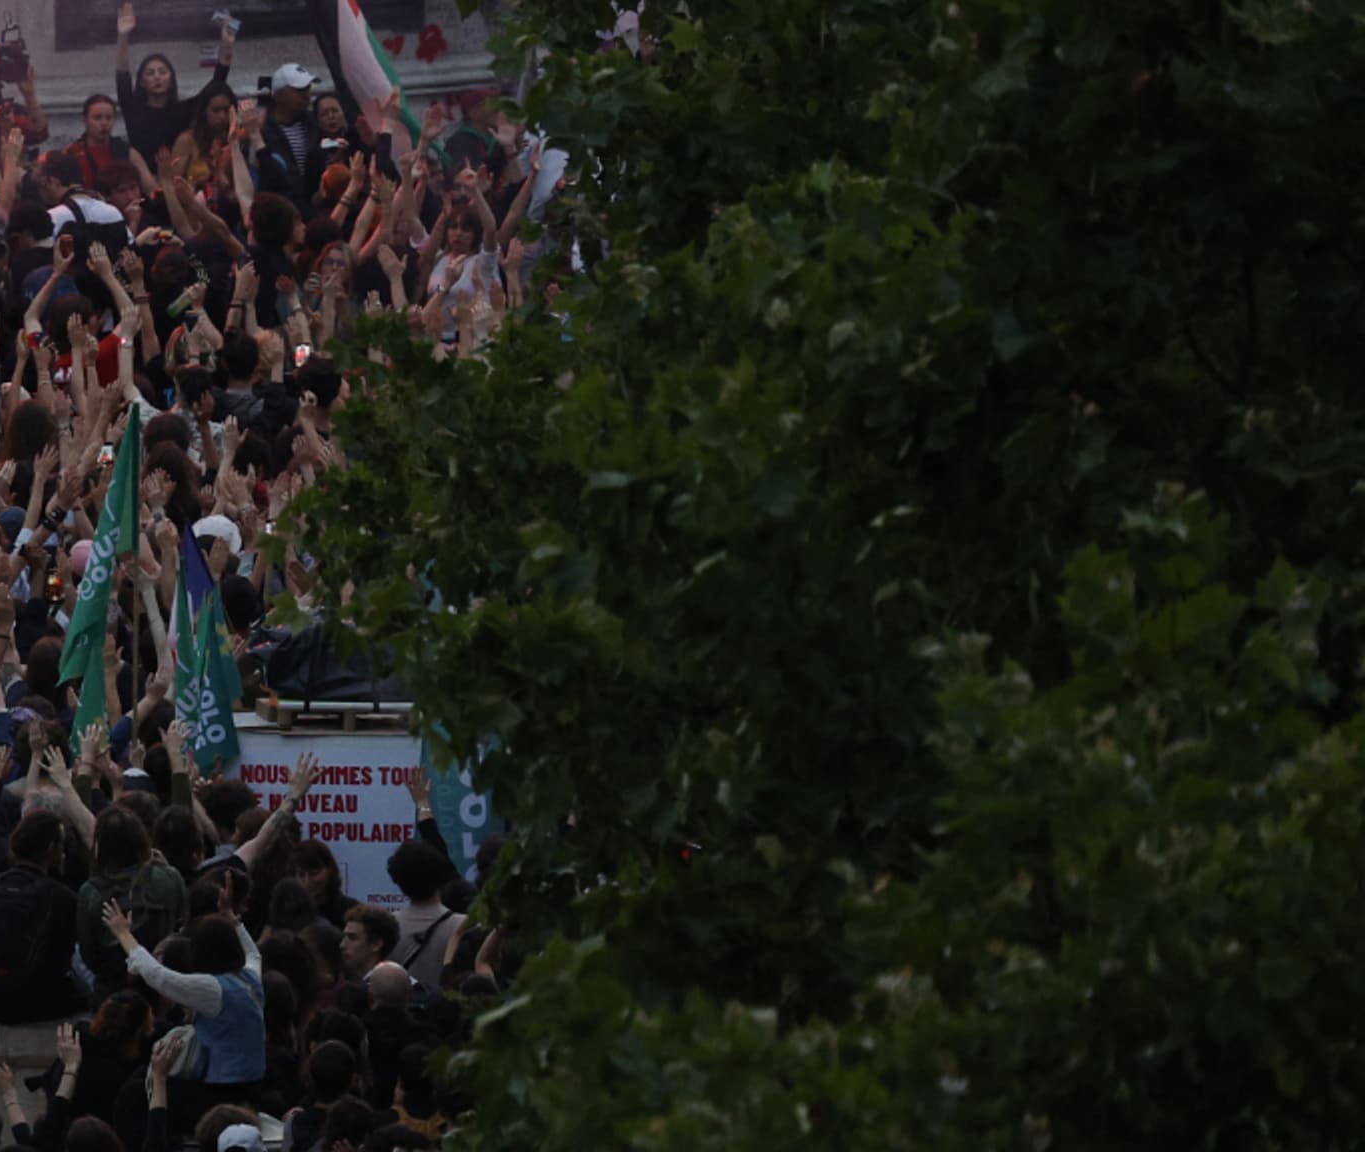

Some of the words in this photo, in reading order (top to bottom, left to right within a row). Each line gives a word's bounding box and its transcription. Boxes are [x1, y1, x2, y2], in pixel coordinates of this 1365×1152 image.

[240, 764, 289, 784] NOUS
[309, 766, 373, 786] OMMES
[268, 793, 358, 813] NUVEAU
[308, 822, 414, 843] POPULAIRE
